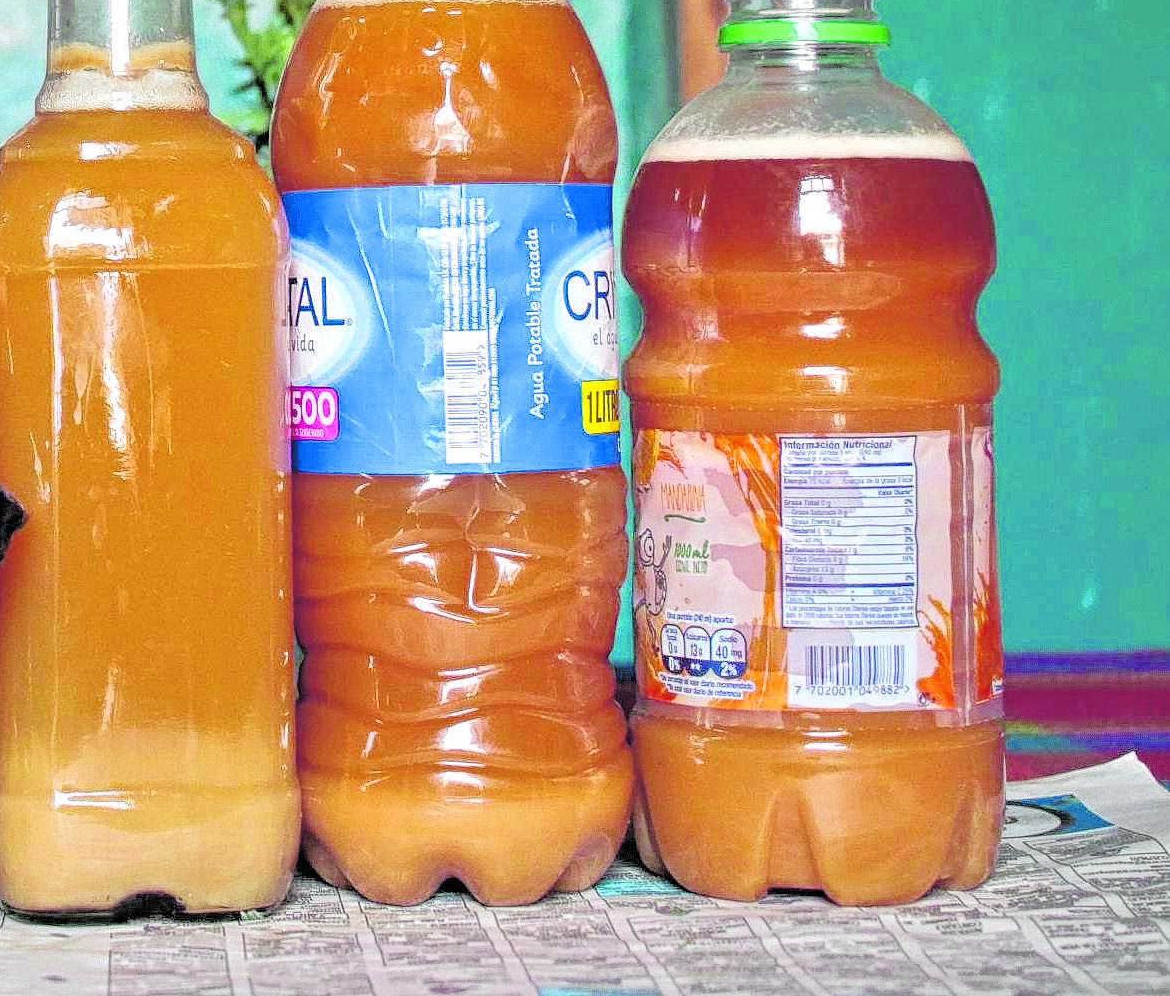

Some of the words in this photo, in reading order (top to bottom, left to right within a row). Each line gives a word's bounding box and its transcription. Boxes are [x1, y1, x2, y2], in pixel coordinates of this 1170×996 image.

[525, 227, 541, 299] Tratada
[563, 270, 615, 321] CR
[291, 333, 315, 353] vida
[527, 302, 544, 367] Potable
[593, 327, 603, 346] el
[529, 371, 549, 419] Agua
[587, 391, 593, 423] 1
[595, 389, 619, 423] LITR
[784, 440, 840, 450] Información
[843, 440, 893, 450] Nutricional
[715, 645, 728, 659] 40
[720, 662, 737, 676] 2%
[794, 685, 801, 695] 7
[810, 685, 853, 696] 702001
